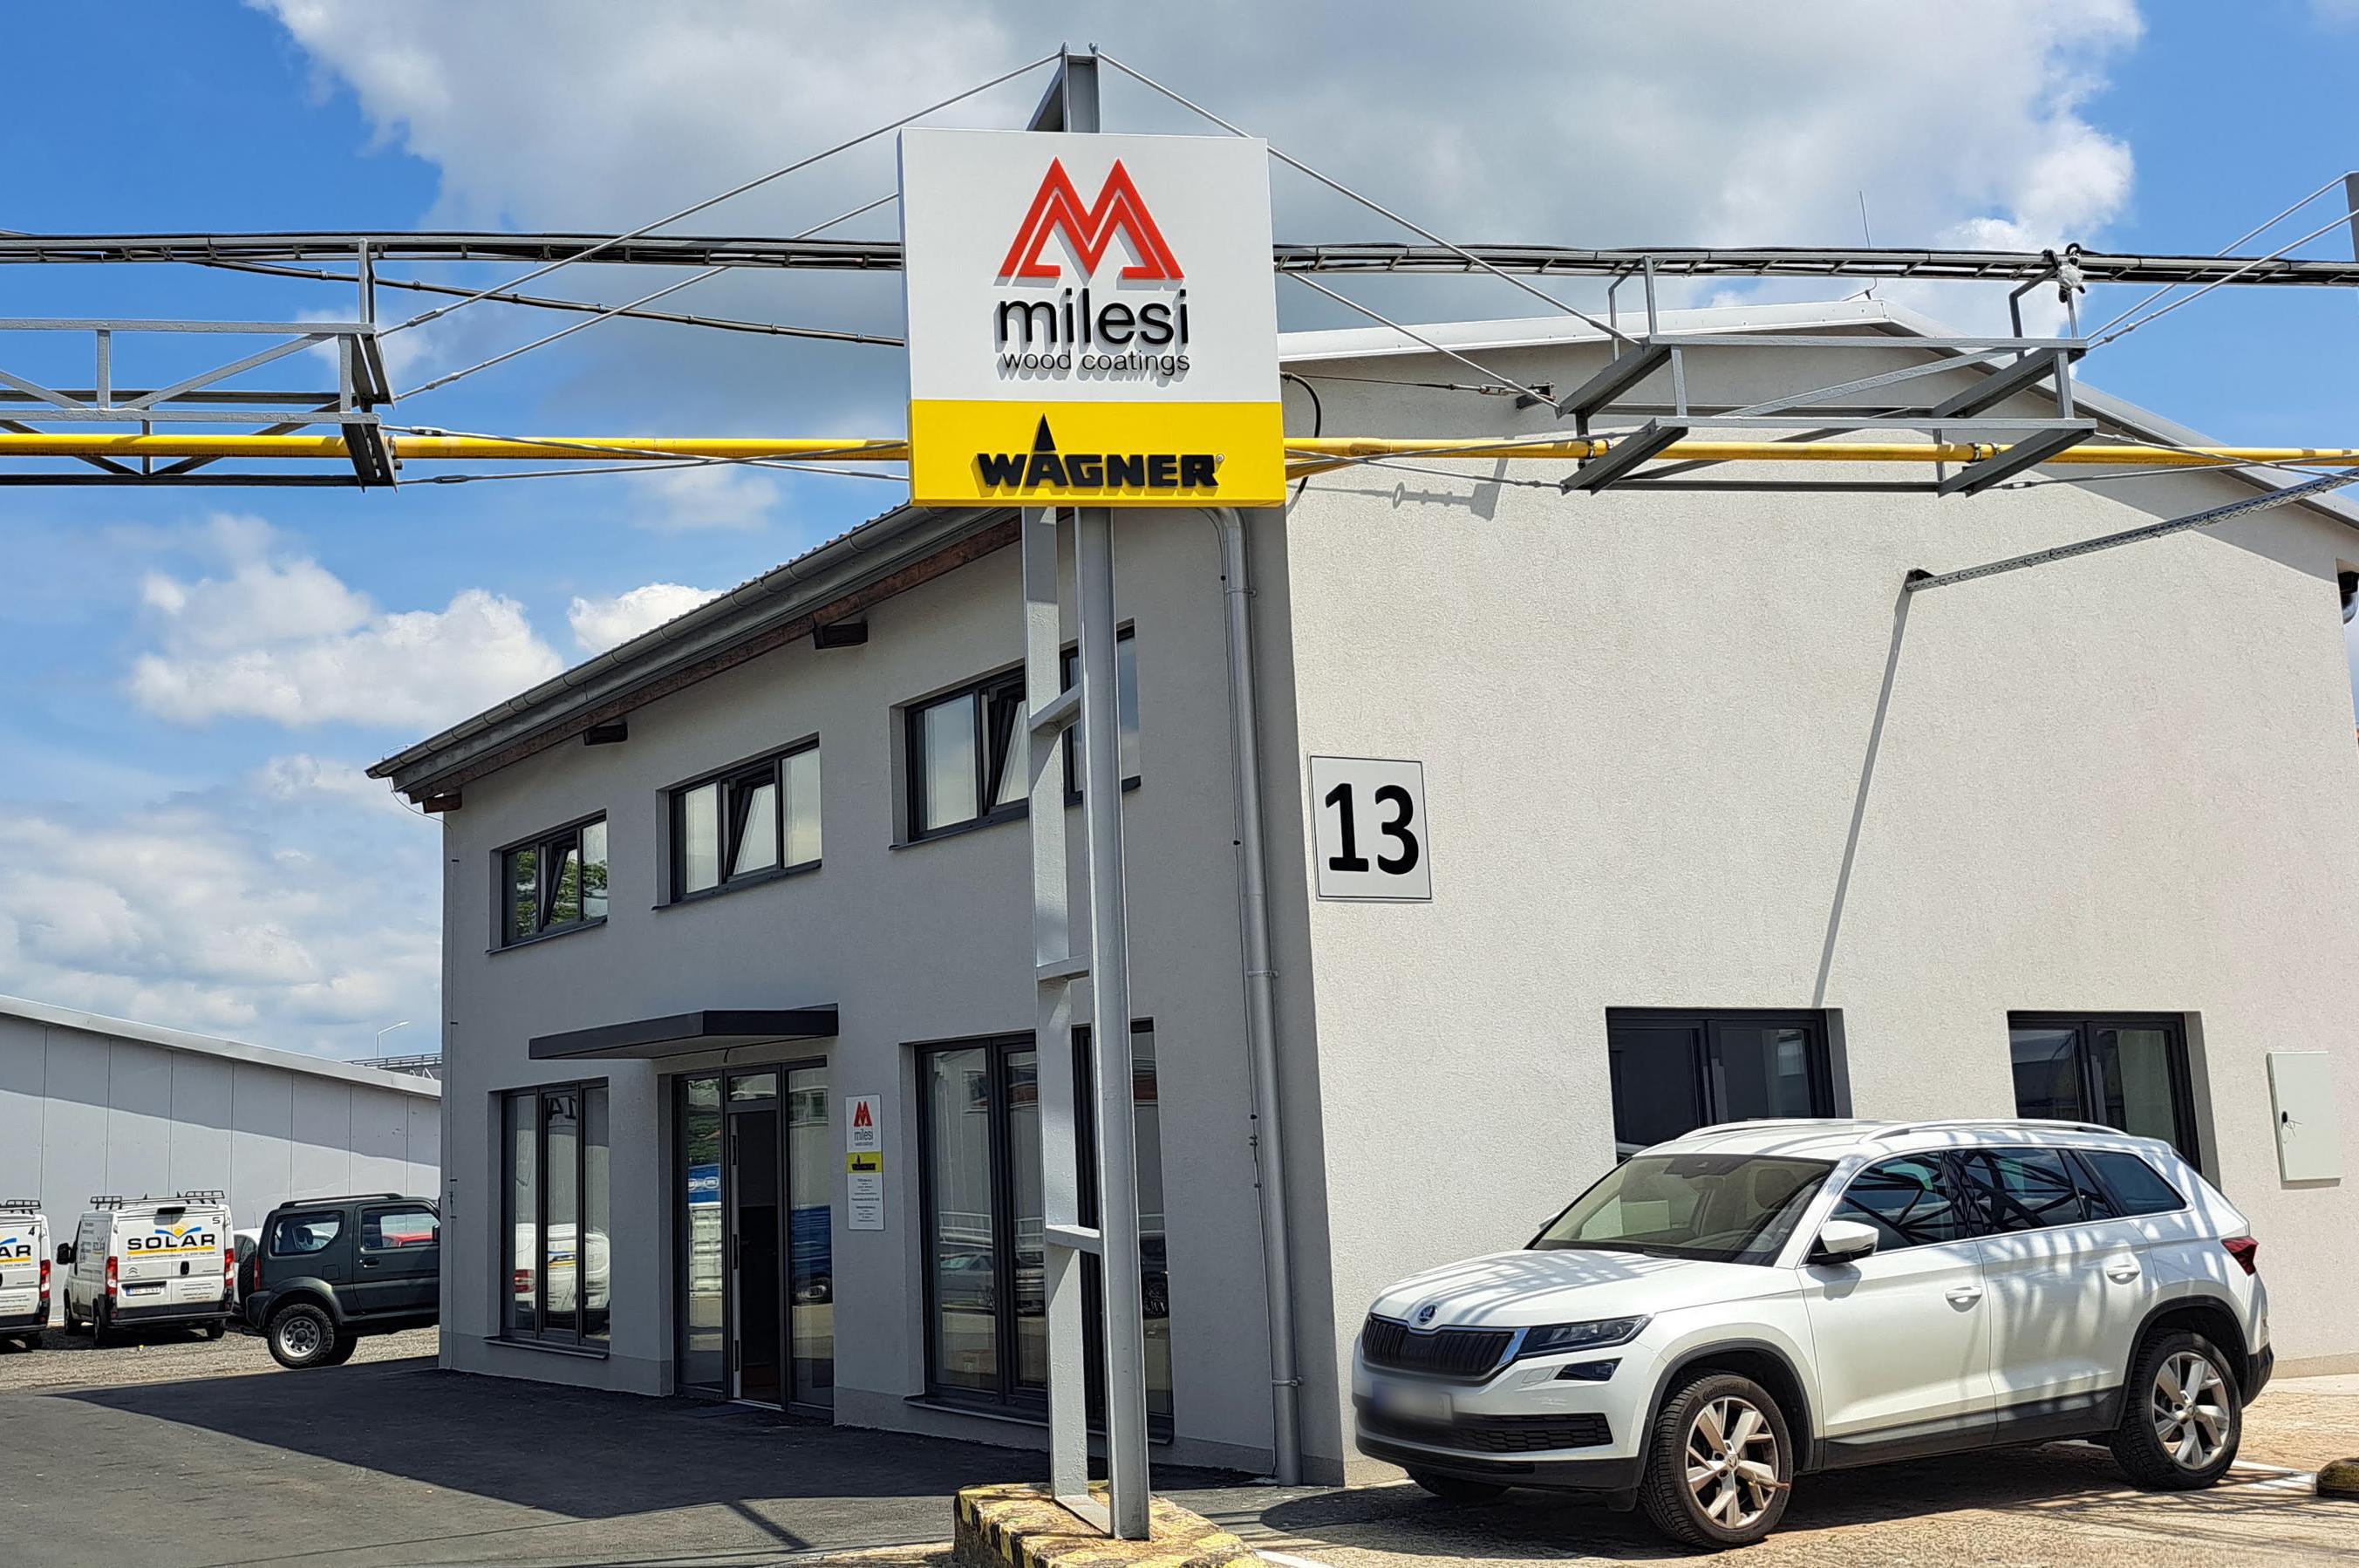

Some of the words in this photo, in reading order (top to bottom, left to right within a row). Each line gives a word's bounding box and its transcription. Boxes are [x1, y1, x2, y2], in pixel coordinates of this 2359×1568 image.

[999, 288, 1189, 345] milesi
[1003, 349, 1072, 370] wood
[1081, 350, 1190, 377] coatings
[976, 412, 1219, 487] WAGNER
[1325, 782, 1420, 876] 13
[28, 1226, 36, 1236] 4
[127, 1234, 215, 1251] SOLAR
